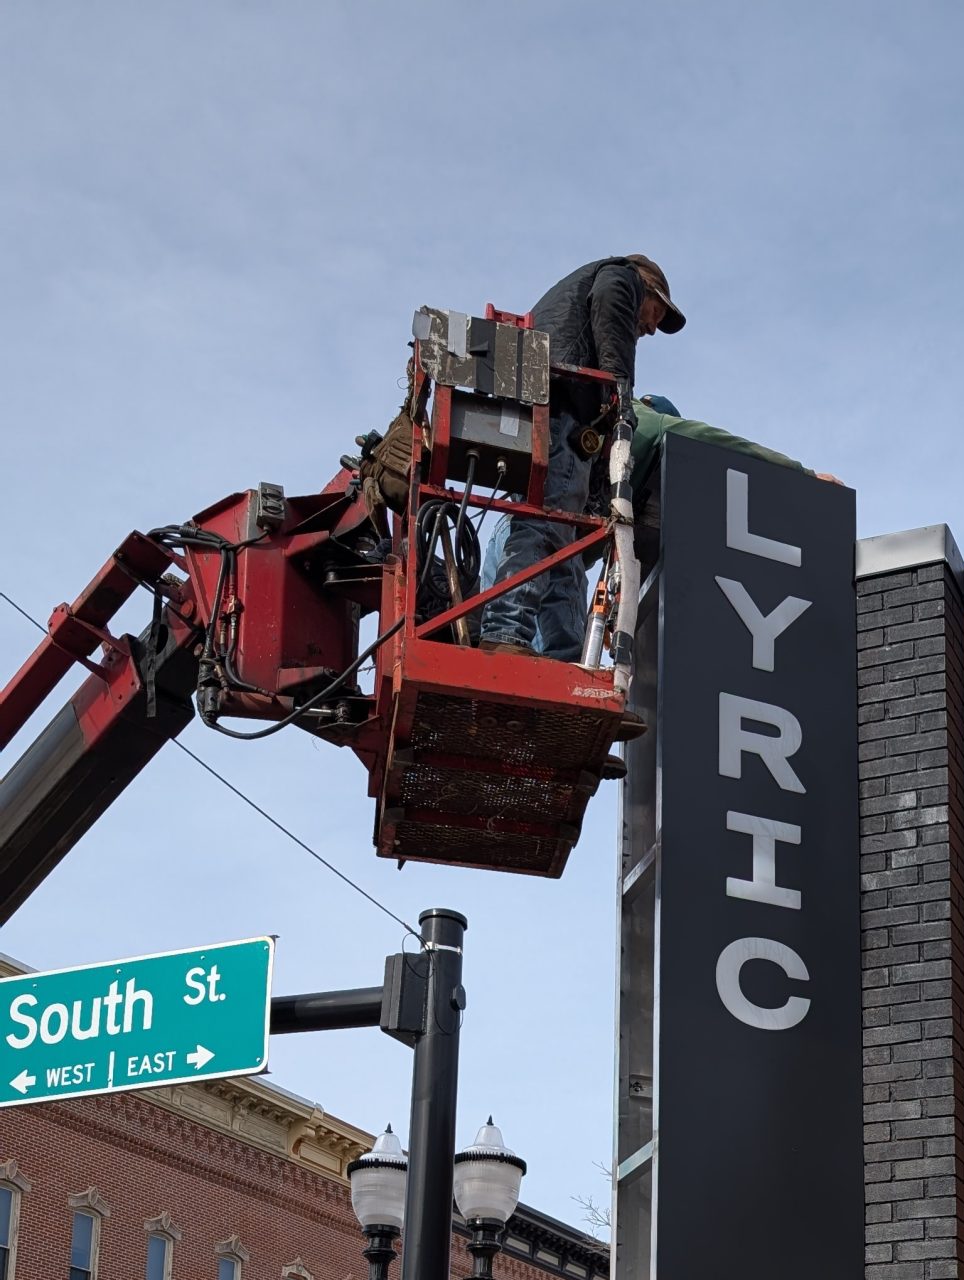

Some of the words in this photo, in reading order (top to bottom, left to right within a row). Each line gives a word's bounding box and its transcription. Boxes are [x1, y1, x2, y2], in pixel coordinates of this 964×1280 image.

[715, 468, 812, 1030] LYRIC
[6, 978, 153, 1049] South
[183, 964, 227, 1005] St.
[46, 1063, 95, 1088] WEST
[127, 1051, 176, 1077] EAST
